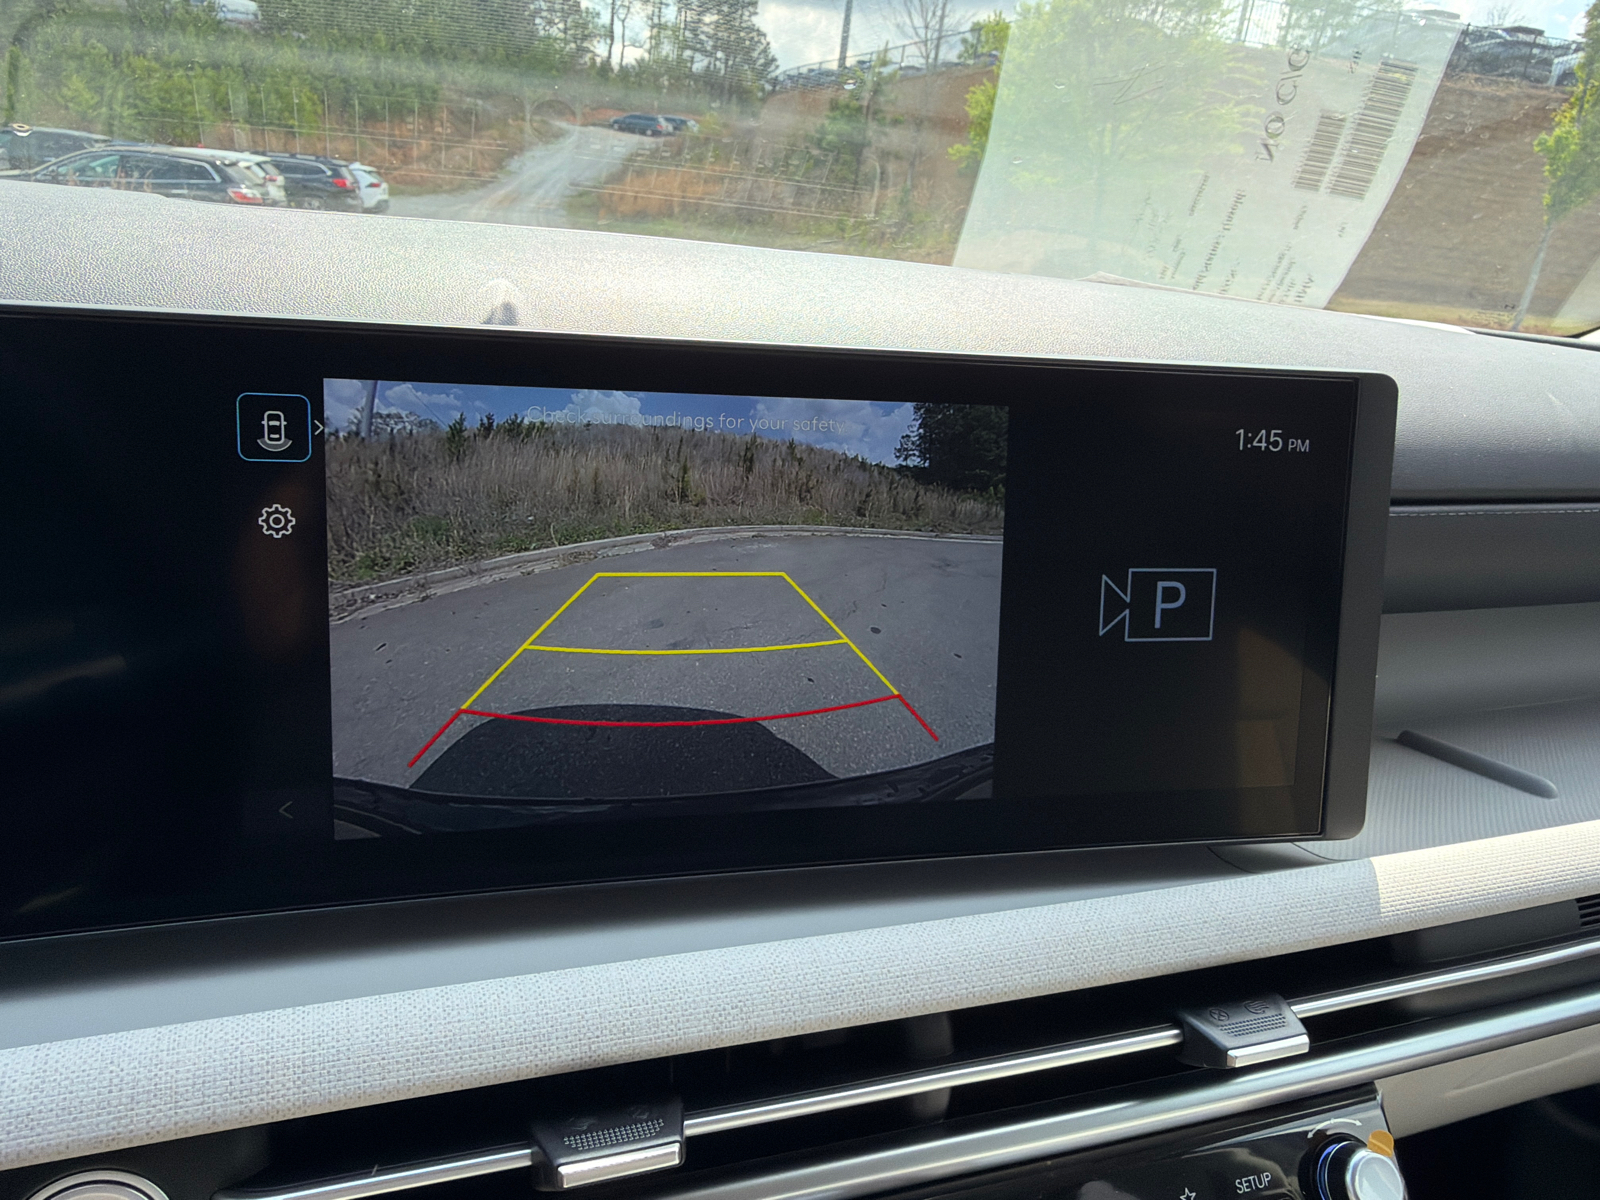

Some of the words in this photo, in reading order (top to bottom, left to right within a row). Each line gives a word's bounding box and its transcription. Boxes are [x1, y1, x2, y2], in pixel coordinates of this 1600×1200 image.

[527, 404, 586, 424] Check
[592, 410, 714, 432] surroundings
[718, 412, 744, 429] for
[749, 416, 787, 433] your
[1235, 428, 1283, 451] 1:45
[1288, 439, 1310, 452] PM
[1154, 581, 1186, 629] P
[1235, 1172, 1272, 1194] SETUP
